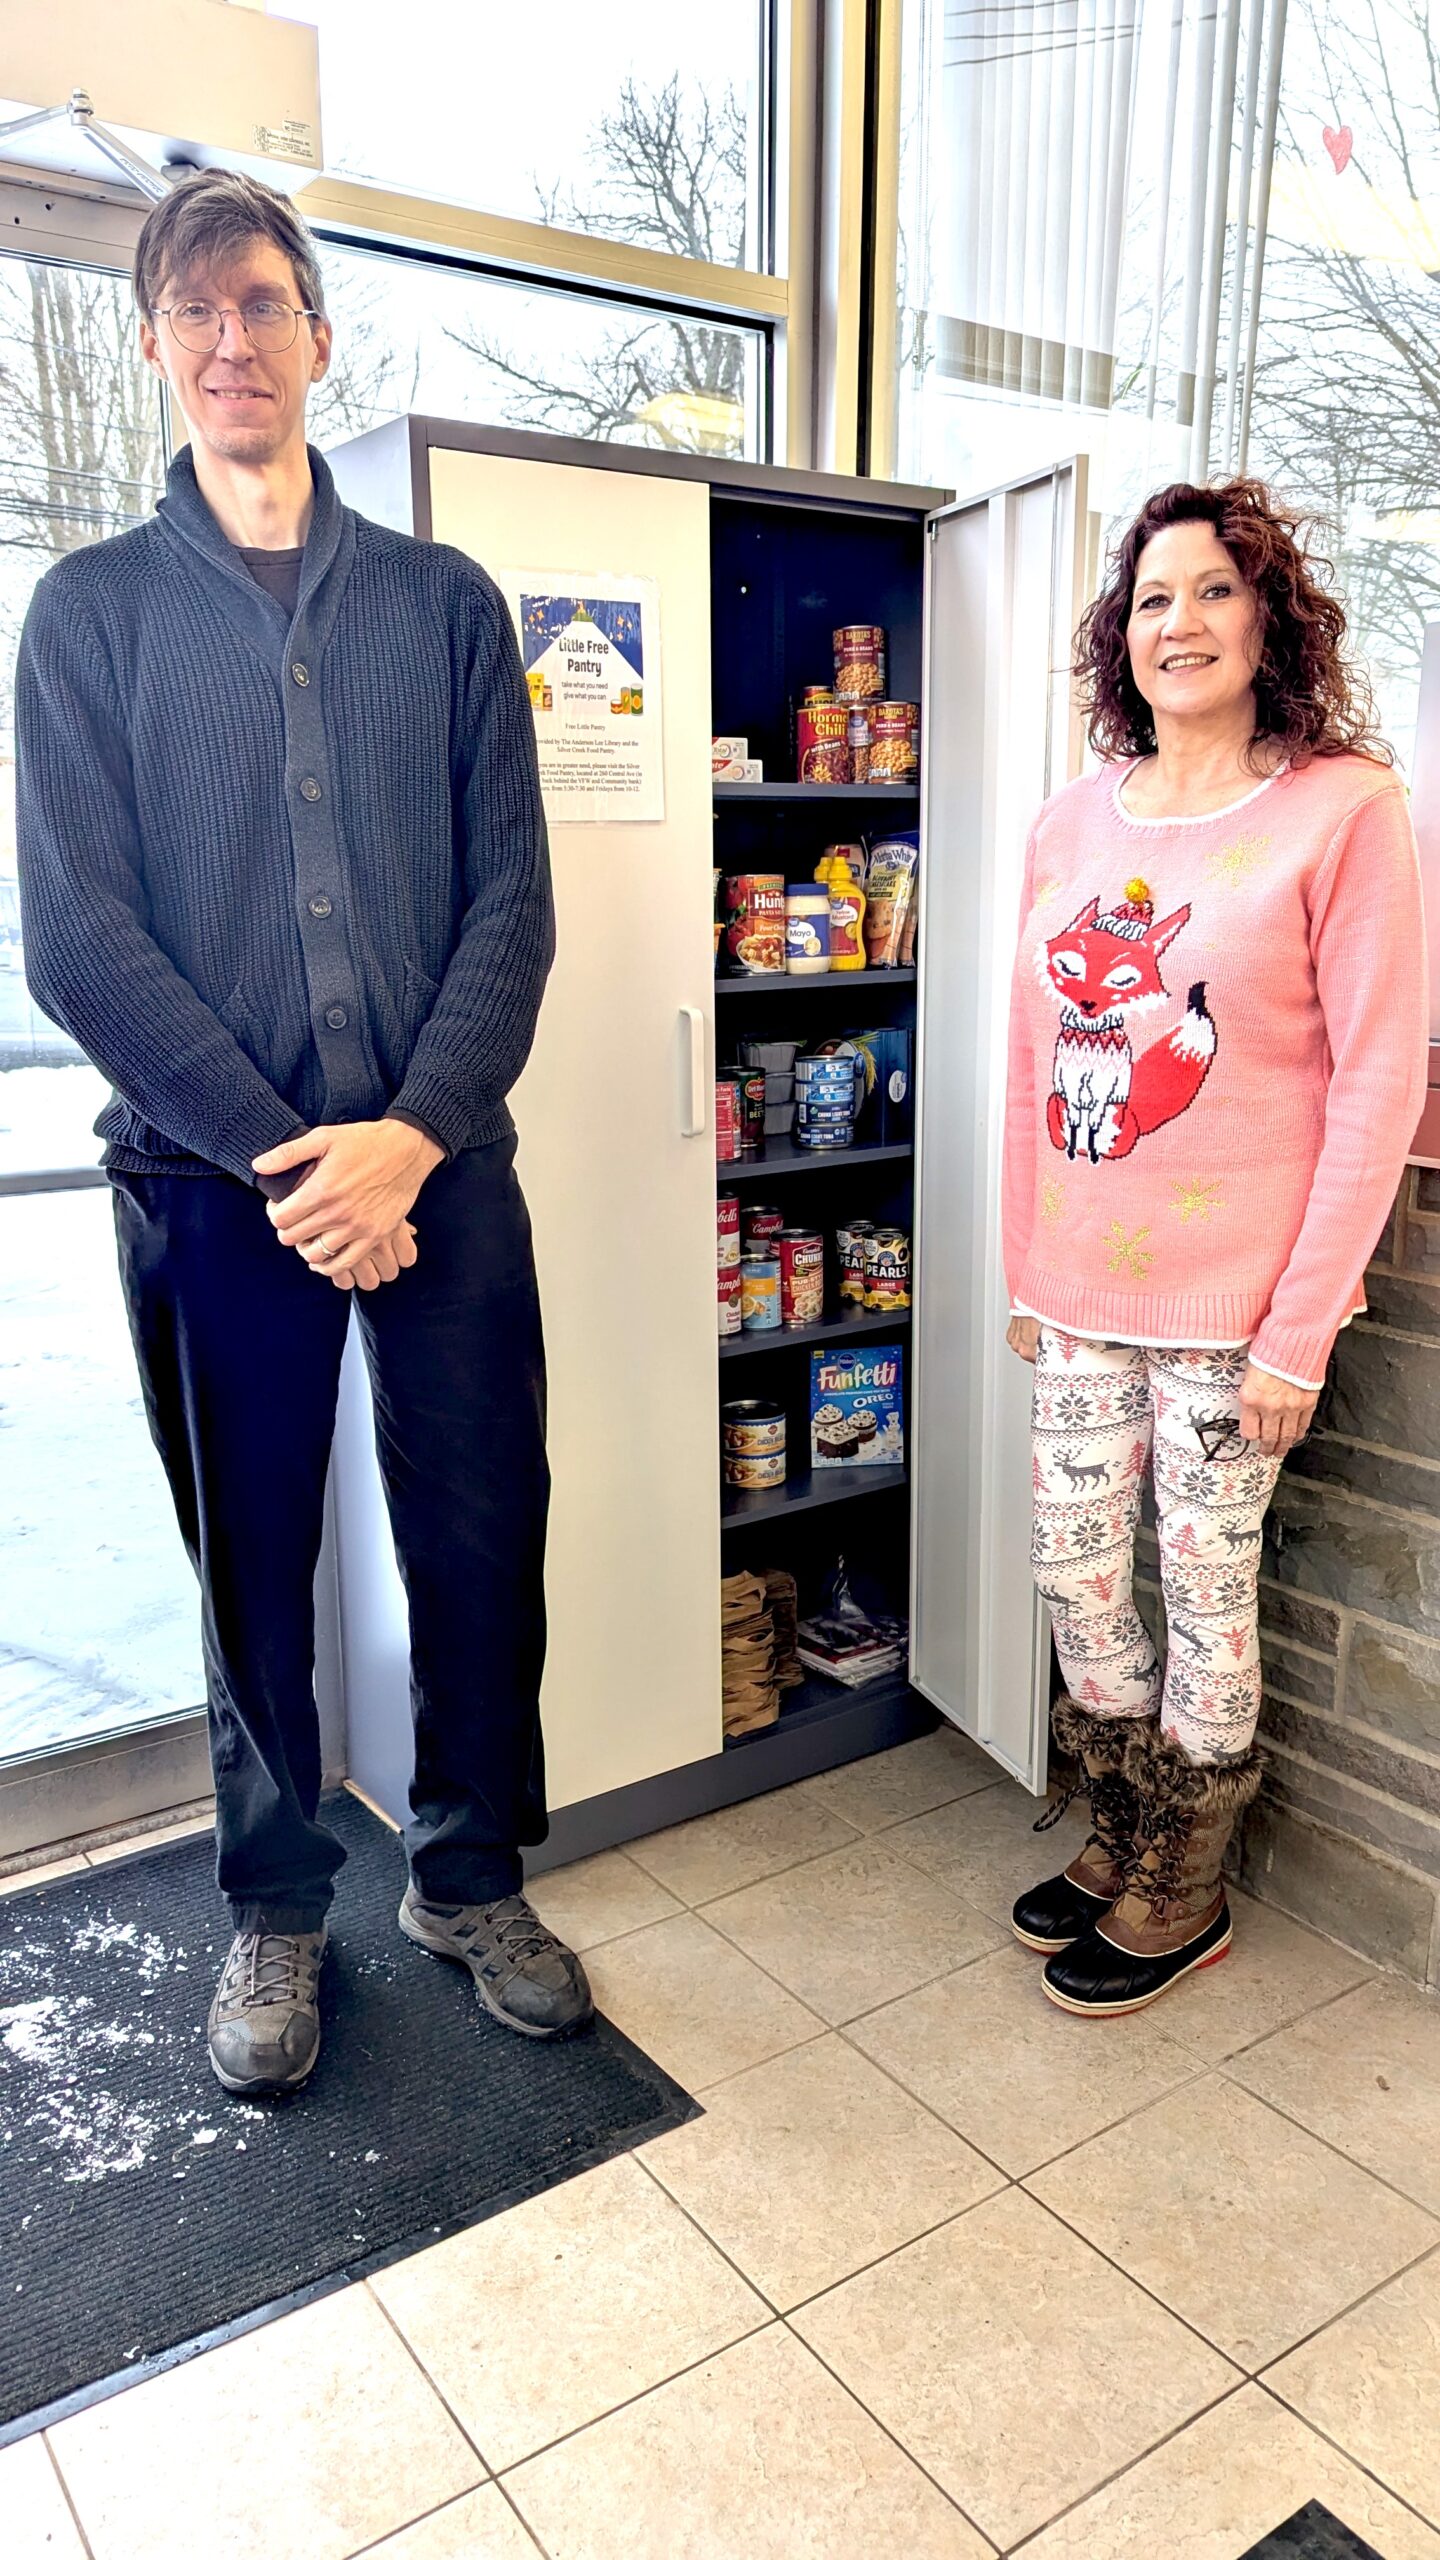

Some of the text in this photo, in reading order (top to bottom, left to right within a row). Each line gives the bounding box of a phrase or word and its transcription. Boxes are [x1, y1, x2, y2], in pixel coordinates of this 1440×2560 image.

[559, 637, 609, 655] Little Free
[567, 658, 602, 677] Pantry
[563, 692, 574, 700] give
[808, 710, 848, 724] Horme
[815, 722, 846, 736] Chili
[605, 740, 621, 748] Library
[825, 740, 841, 750] Beans
[601, 778, 627, 786] Community
[596, 786, 613, 794] Fridays
[831, 913, 855, 921] Mustard
[789, 930, 812, 938] Mayo
[840, 1254, 864, 1269] PEA
[866, 1263, 907, 1279] PEARLS
[817, 1361, 896, 1391] Funfetti
[853, 1393, 894, 1408] OREO
